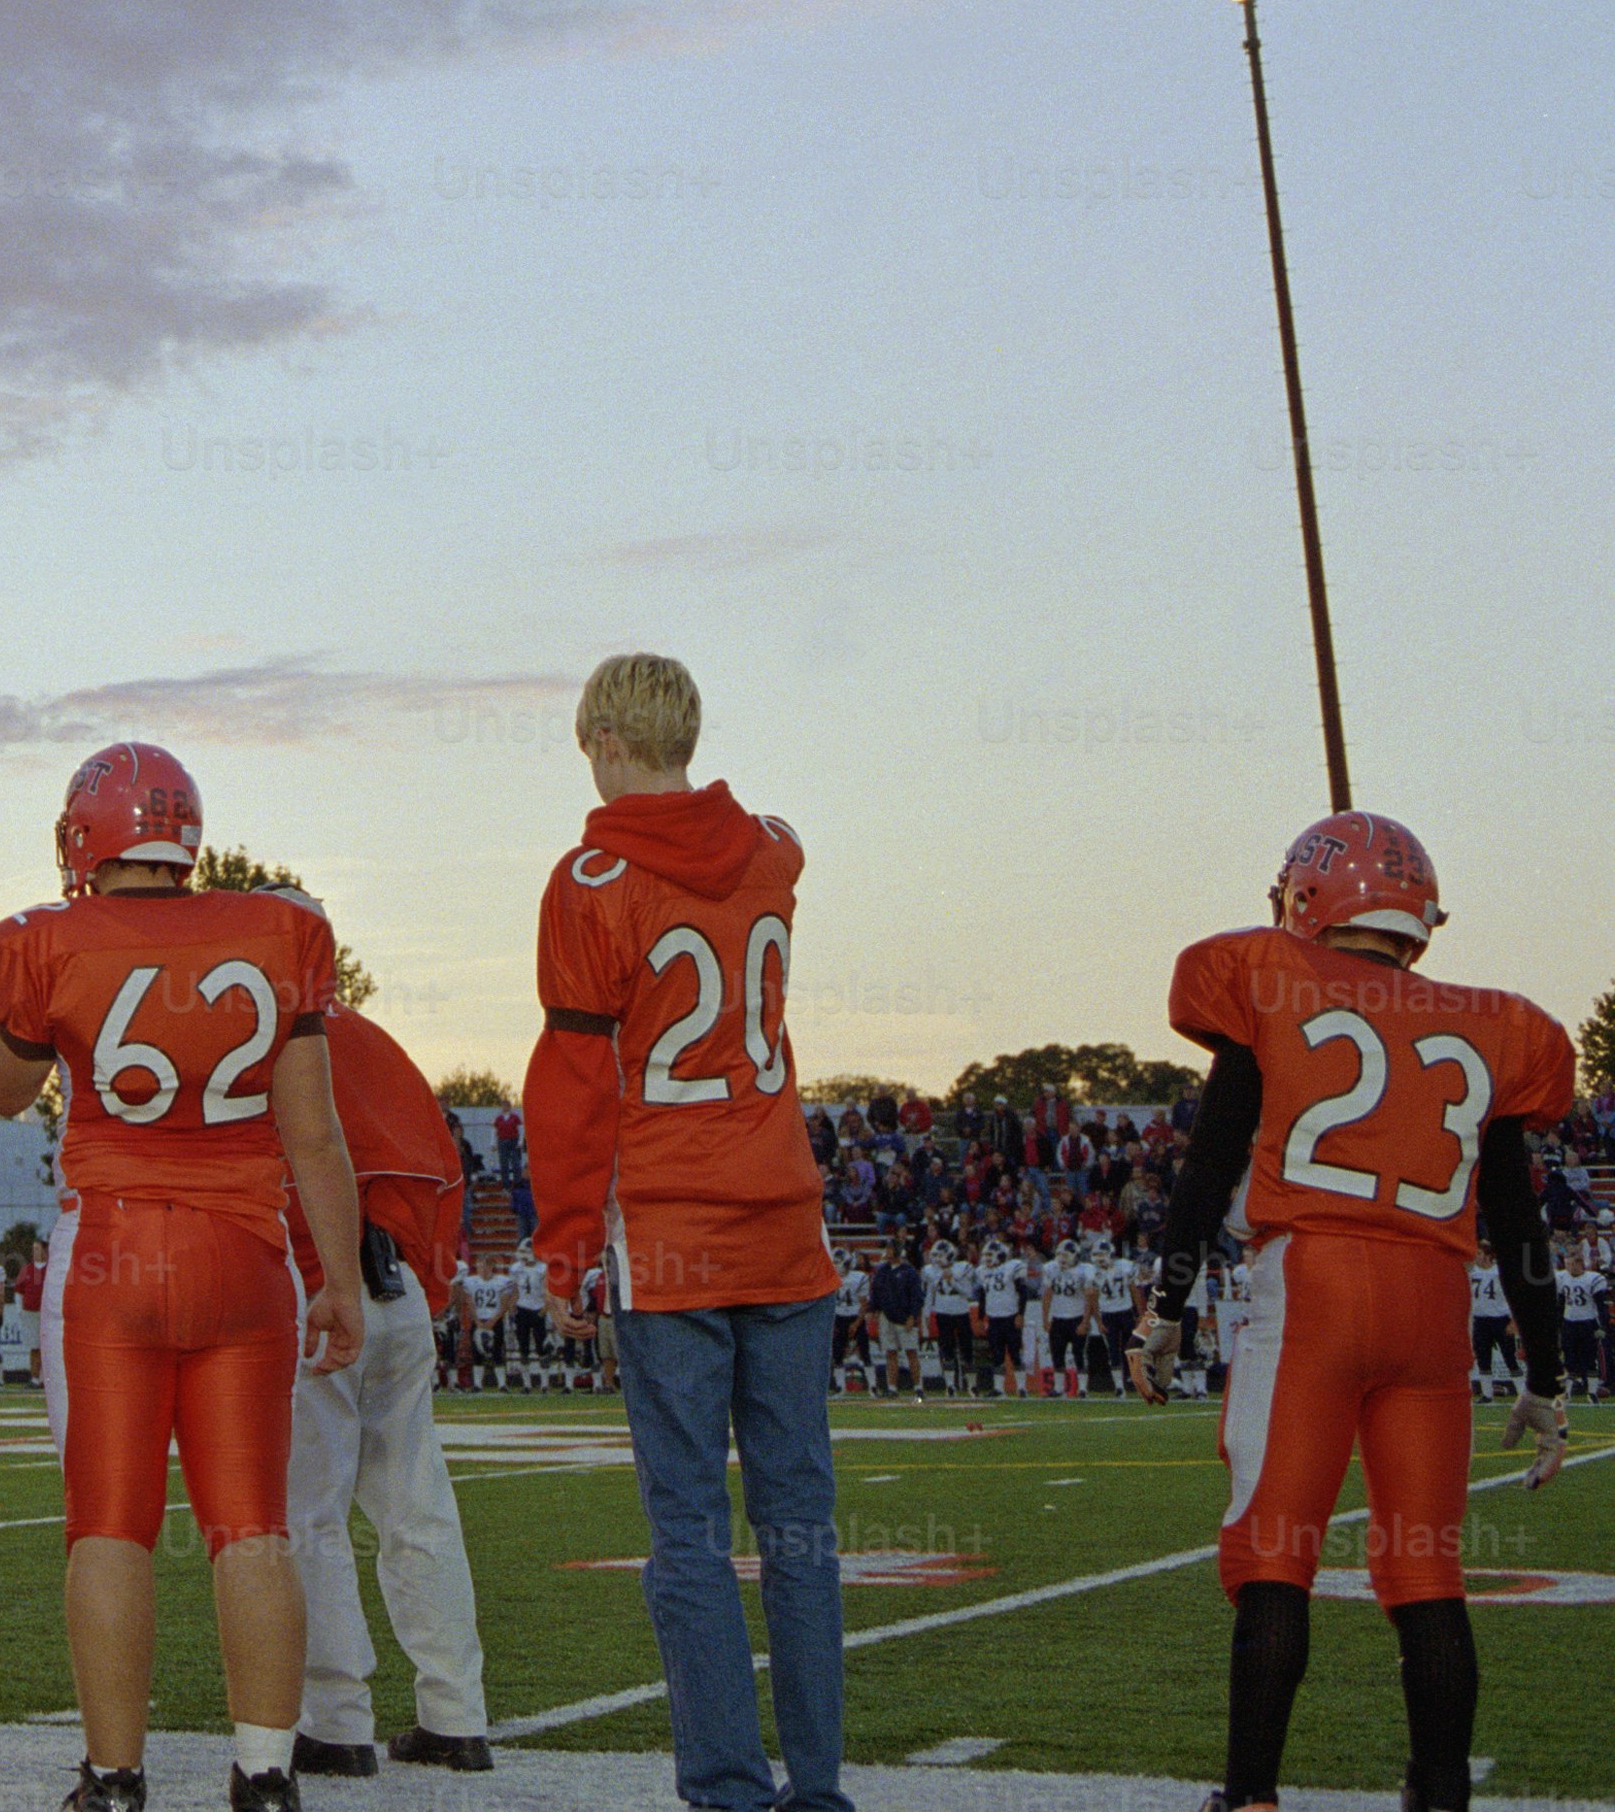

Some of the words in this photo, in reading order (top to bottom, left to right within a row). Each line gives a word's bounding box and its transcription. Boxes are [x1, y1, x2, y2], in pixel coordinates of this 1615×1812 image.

[150, 788, 191, 820] 62
[93, 959, 278, 1125] 62
[644, 914, 791, 1106] 20
[1282, 1010, 1494, 1220] 23
[474, 1289, 497, 1308] 62
[1471, 1279, 1496, 1300] 74
